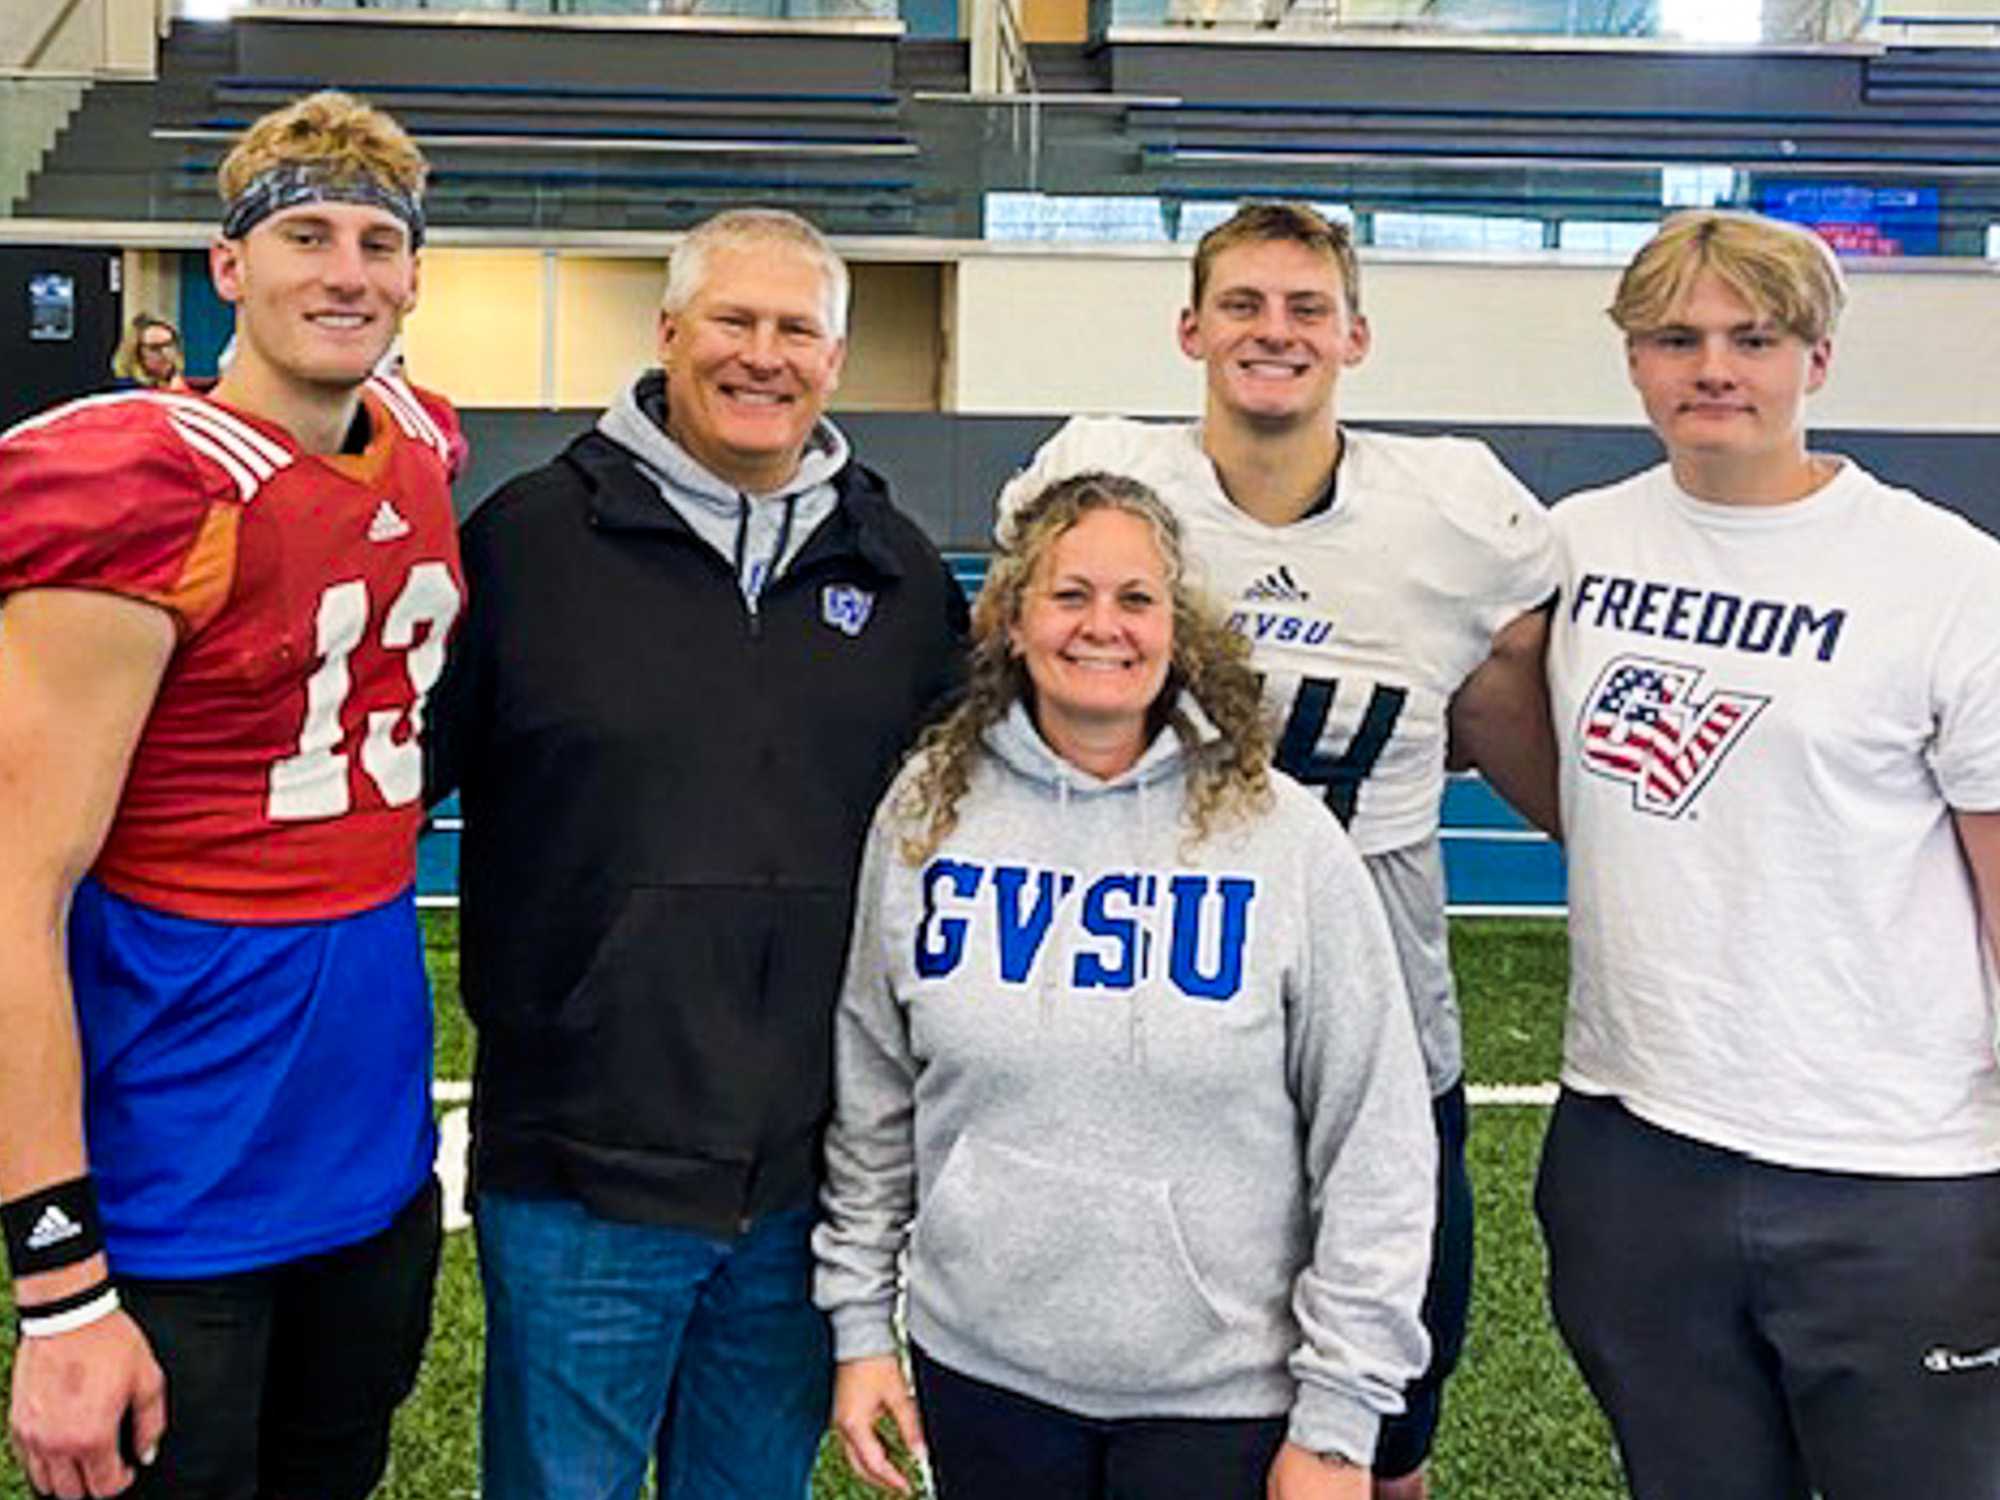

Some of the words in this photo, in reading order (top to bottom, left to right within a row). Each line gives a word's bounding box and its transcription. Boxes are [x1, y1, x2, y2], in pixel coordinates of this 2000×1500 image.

[1571, 572, 1848, 663] FREEDOM
[268, 561, 461, 821] 13
[914, 857, 1256, 1002] GVSU
